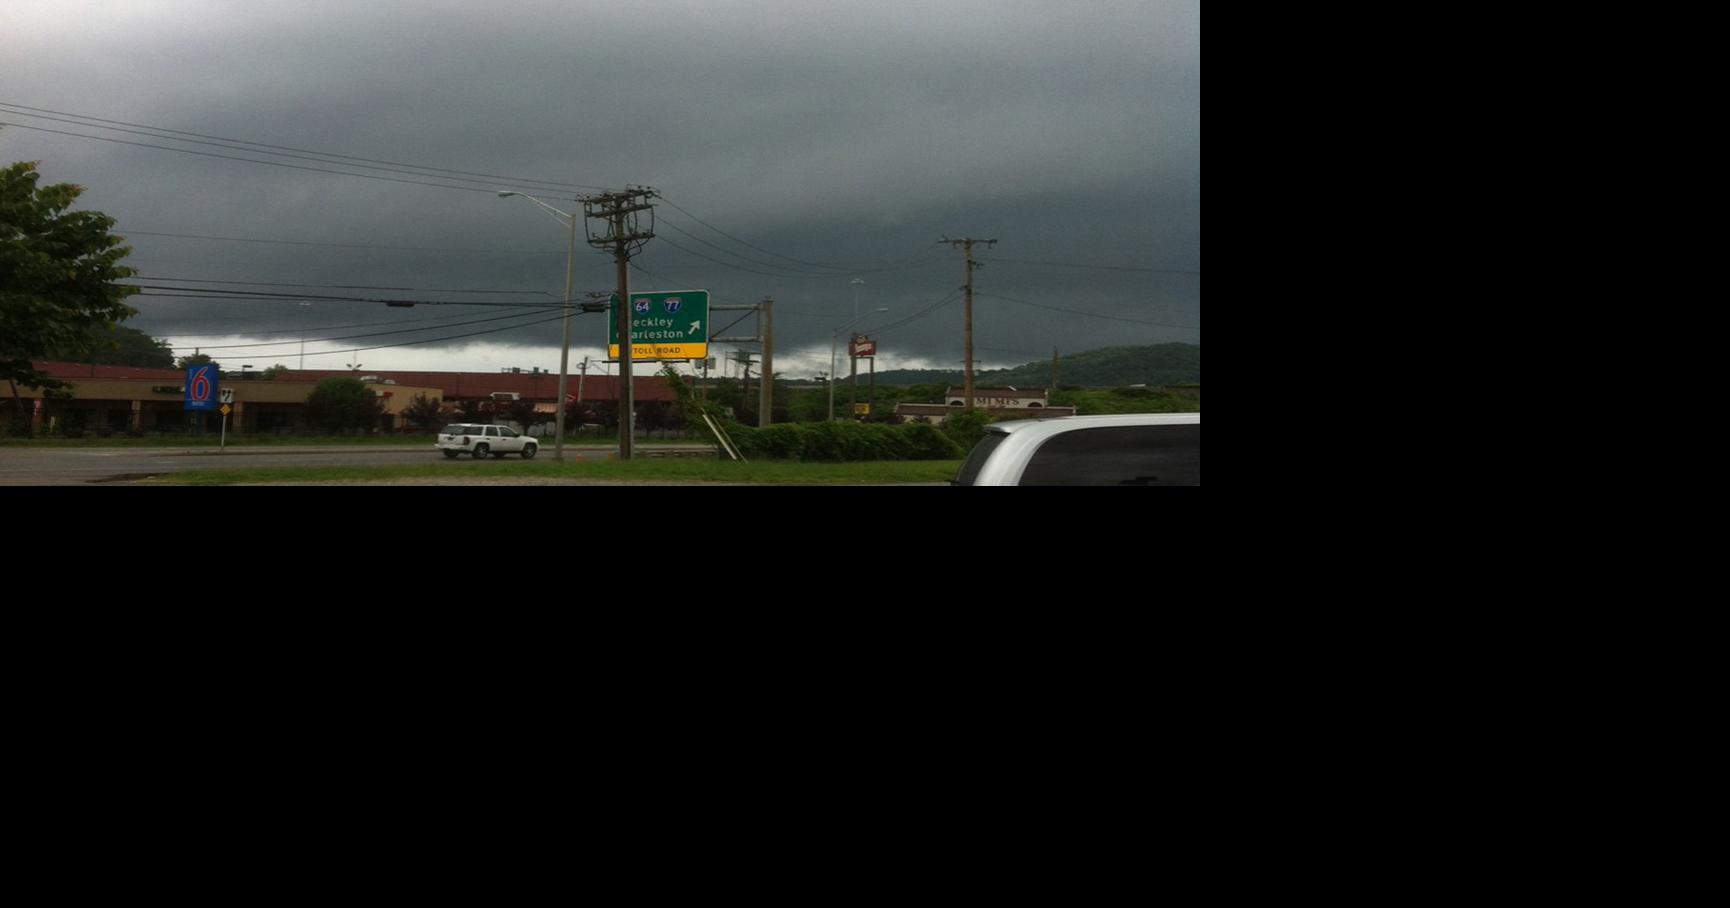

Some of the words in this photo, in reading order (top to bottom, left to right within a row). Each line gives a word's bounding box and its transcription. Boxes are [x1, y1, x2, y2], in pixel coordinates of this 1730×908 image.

[635, 302, 649, 312] 64
[665, 301, 679, 310] 77
[632, 318, 673, 329] eckley
[616, 330, 684, 340] arleston
[633, 347, 653, 355] TOLL
[191, 366, 210, 401] 6
